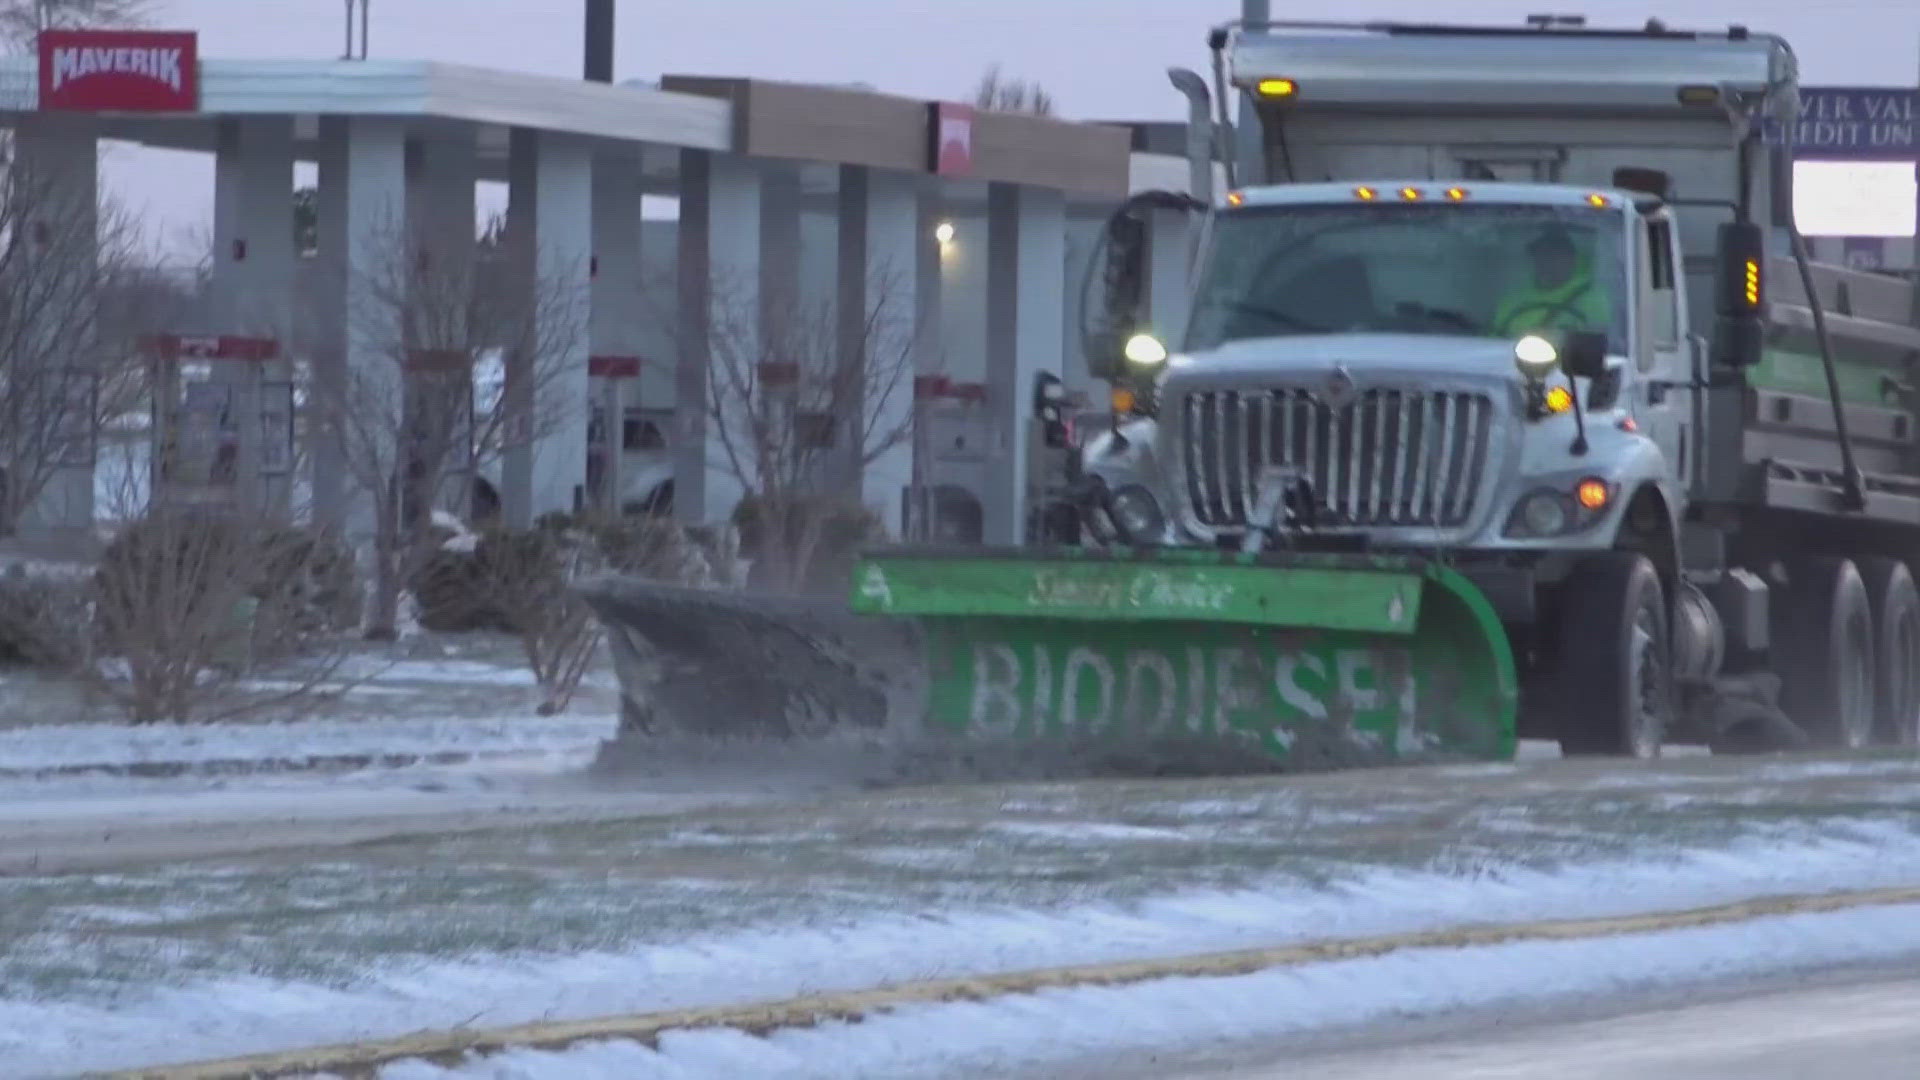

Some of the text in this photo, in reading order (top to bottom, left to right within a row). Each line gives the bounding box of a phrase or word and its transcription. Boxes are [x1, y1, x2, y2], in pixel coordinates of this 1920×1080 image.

[53, 47, 182, 94] MAVERIK
[1762, 96, 1853, 119] RVER
[967, 642, 1441, 754] BIODIESEL
